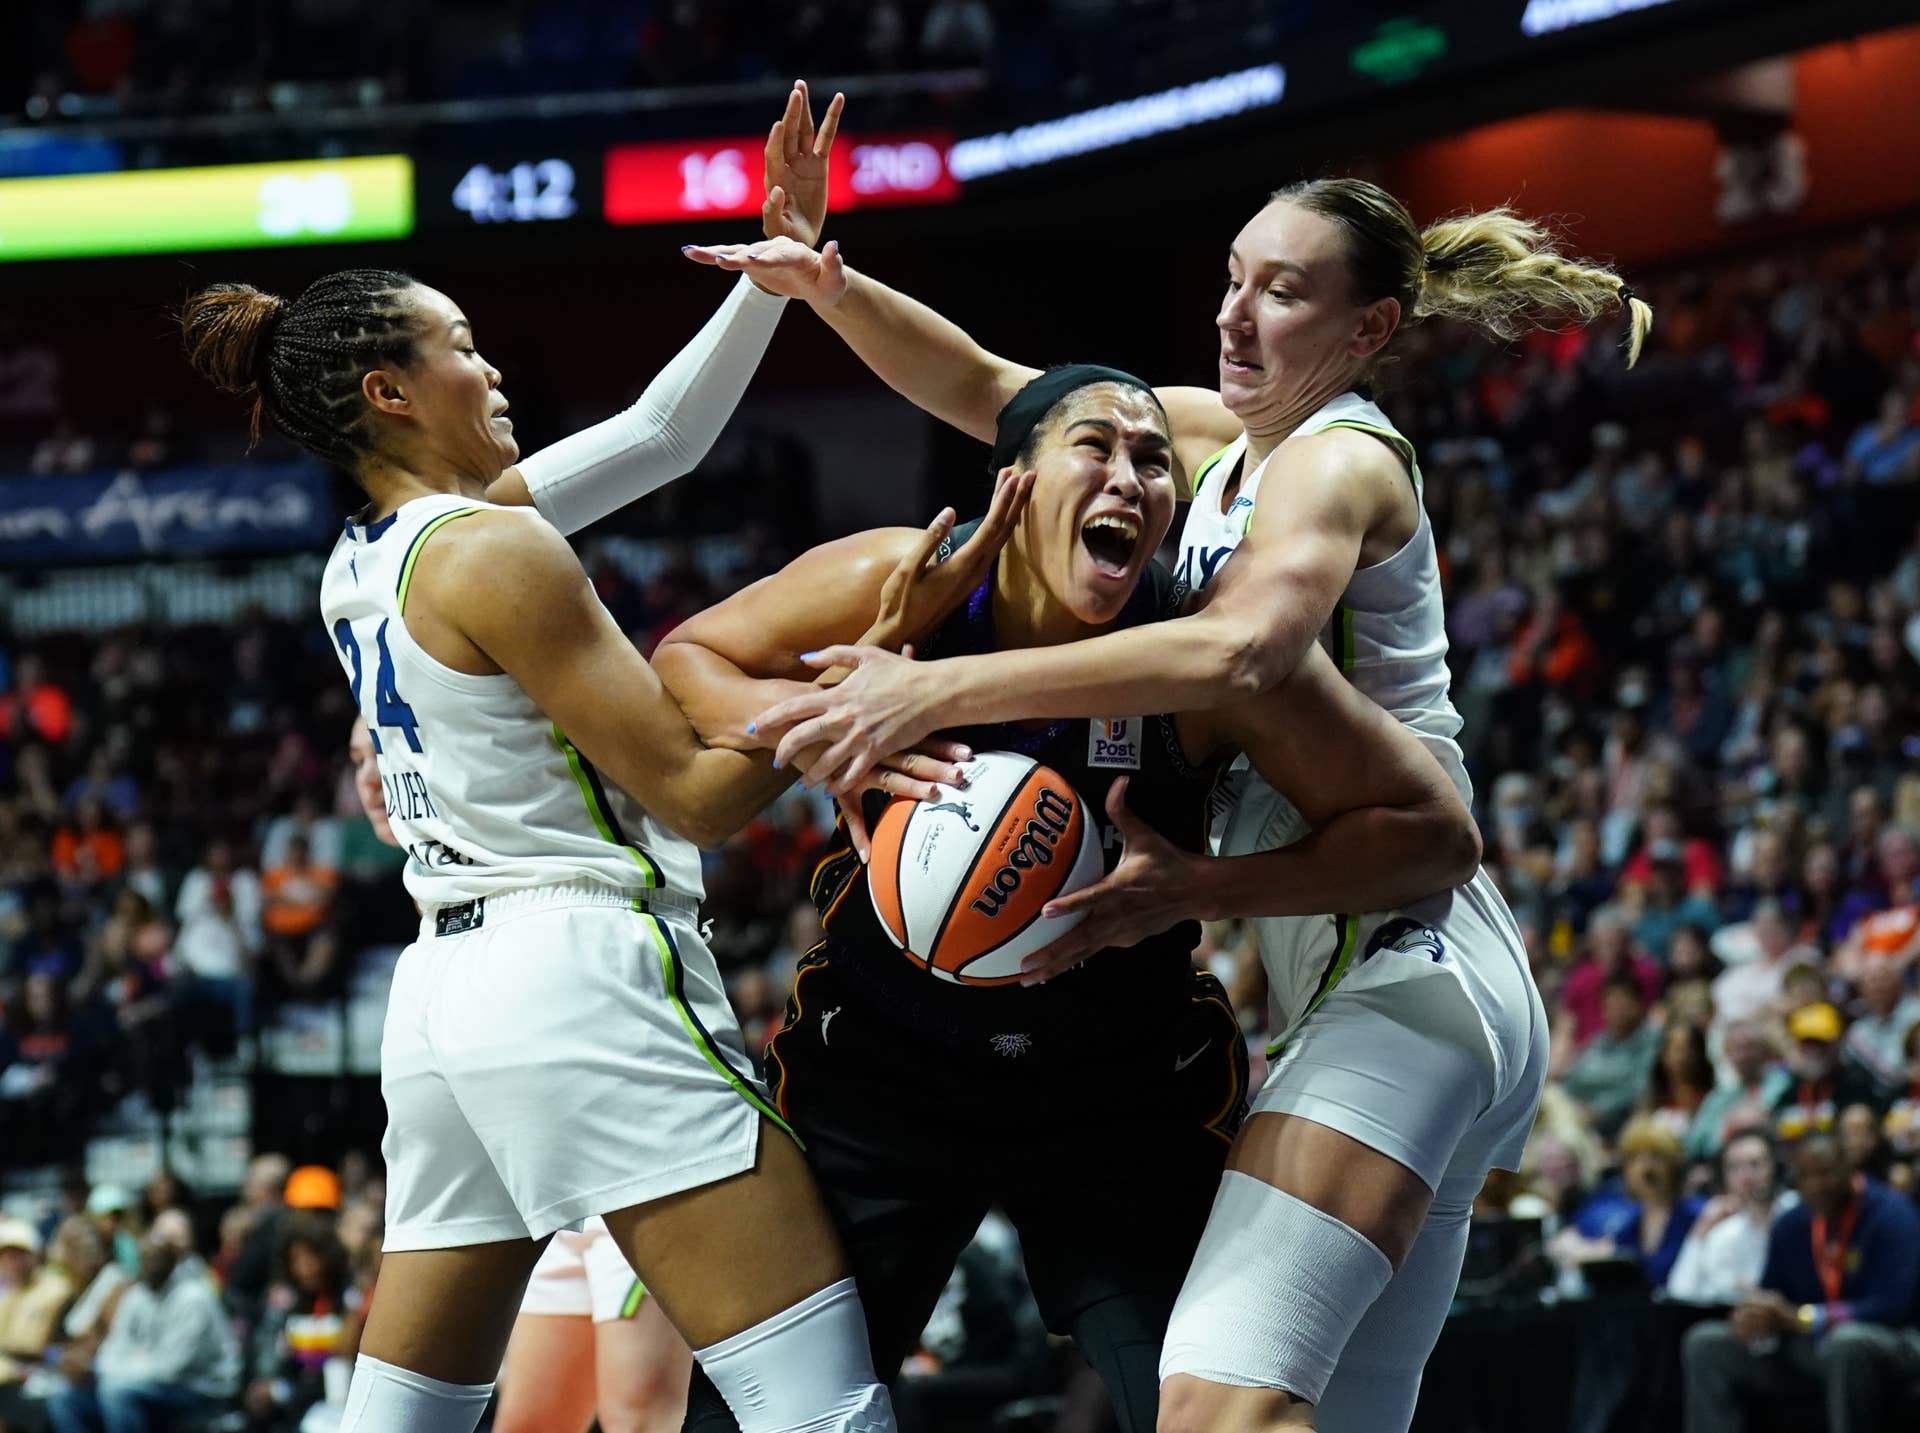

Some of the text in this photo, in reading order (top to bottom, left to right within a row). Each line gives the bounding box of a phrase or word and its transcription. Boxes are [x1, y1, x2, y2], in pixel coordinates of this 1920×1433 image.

[453, 160, 577, 222] 4:12
[678, 148, 749, 211] 16
[851, 142, 942, 194] 2ND
[82, 473, 310, 550] Arena
[334, 618, 423, 753] 24
[1096, 740, 1136, 757] Post
[971, 787, 1074, 917] Wilson
